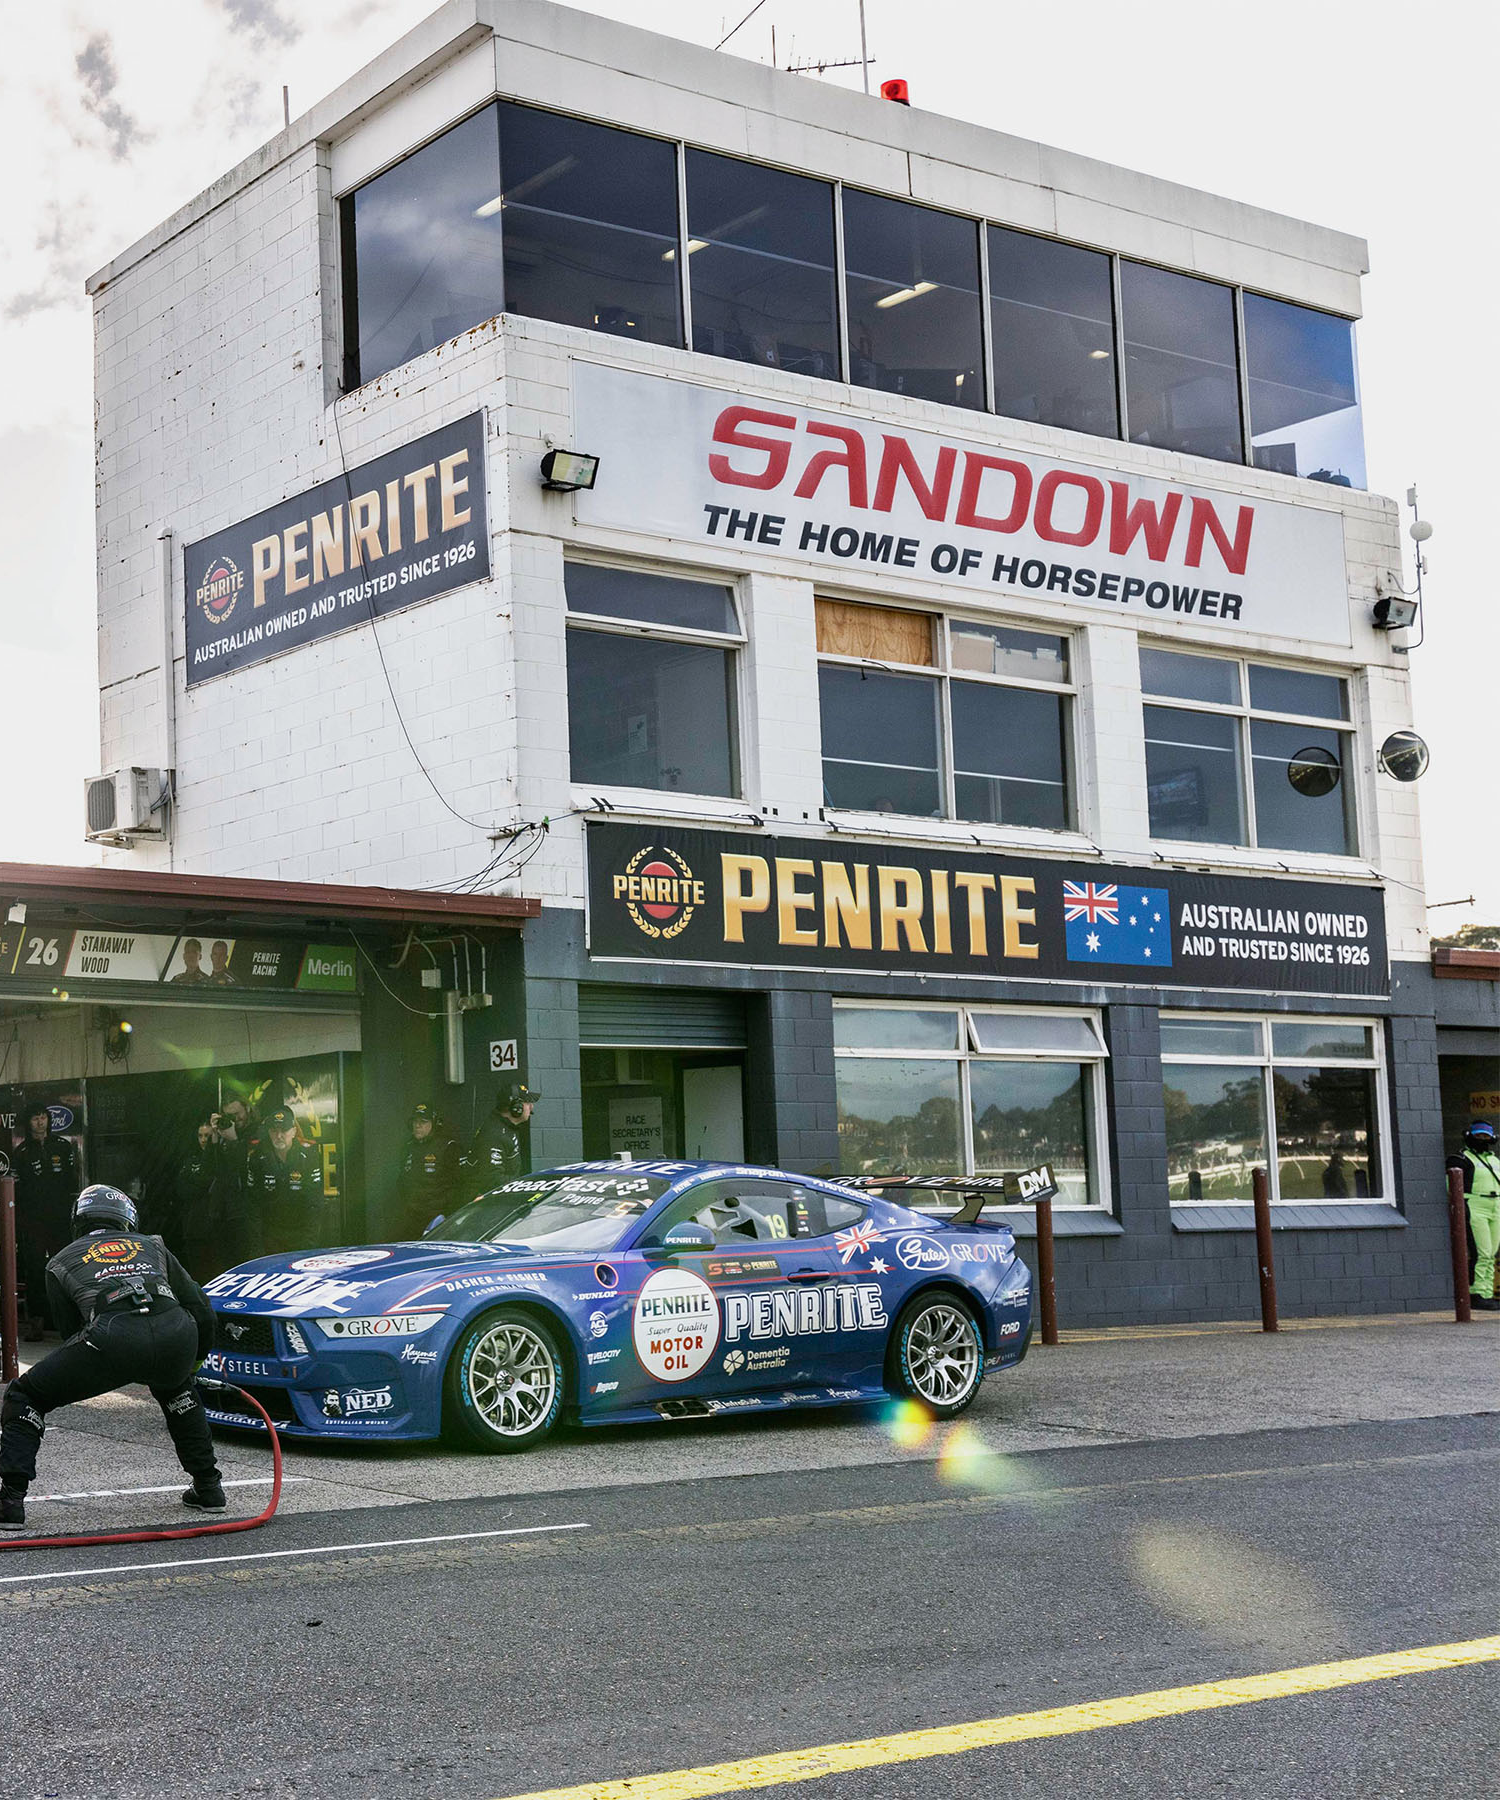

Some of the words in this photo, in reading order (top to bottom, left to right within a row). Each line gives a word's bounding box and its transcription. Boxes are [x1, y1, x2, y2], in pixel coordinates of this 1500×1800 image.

[708, 405, 1254, 576] SANDOWN
[252, 448, 472, 608] PENRITE
[703, 504, 785, 546] THE
[799, 521, 920, 567] HOME
[930, 543, 982, 576] OF
[992, 554, 1244, 621] HORSEPOWER
[196, 570, 244, 606] PENRITE
[194, 624, 263, 664] AUSTRALIAN
[266, 607, 306, 637] OWNED
[310, 594, 336, 619] AND
[339, 573, 397, 608] TRUSTED
[400, 555, 441, 585] SINCE
[443, 540, 476, 570] 1926
[613, 874, 706, 905] PENRITE
[719, 852, 1040, 960] PENRITE
[1180, 903, 1300, 934] AUSTRALIAN
[1304, 912, 1369, 939] OWNED
[26, 937, 59, 966] 26
[81, 935, 135, 955] STANAWAY
[1181, 935, 1216, 958] AND
[1219, 938, 1288, 961] TRUSTED
[1290, 941, 1334, 964] SINCE
[1336, 945, 1371, 967] 1926
[81, 957, 110, 974] WOOD
[252, 952, 281, 964] PENRITE
[307, 958, 353, 977] Merlin
[252, 964, 277, 976] RACING
[491, 1043, 516, 1068] 34
[626, 1115, 647, 1124] RACE
[612, 1127, 661, 1138] SECRETARY'S
[1017, 1166, 1051, 1196] D&M
[764, 1214, 789, 1240] 19
[82, 1241, 145, 1264] PENRITE
[951, 1243, 1008, 1264] GROVE
[94, 1263, 134, 1278] RACING
[445, 1277, 493, 1292] DASHER
[505, 1272, 548, 1283] FISHER
[579, 1290, 618, 1301] DUNLOP
[641, 1294, 711, 1318] PENRITE
[725, 1282, 889, 1342] PENRITE
[347, 1317, 417, 1336] GROVE
[590, 1320, 608, 1329] ACL
[647, 1326, 671, 1336] Super
[677, 1323, 709, 1334] Quality
[1000, 1321, 1020, 1335] FORD
[650, 1336, 703, 1355] MOTOR
[747, 1346, 790, 1361] Dementia
[901, 1323, 913, 1386] DUNLOP
[228, 1360, 269, 1375] STEEL
[664, 1354, 689, 1371] OIL
[746, 1358, 787, 1372] Australia
[345, 1391, 393, 1412] NED
[545, 1360, 562, 1430] DUNLOP
